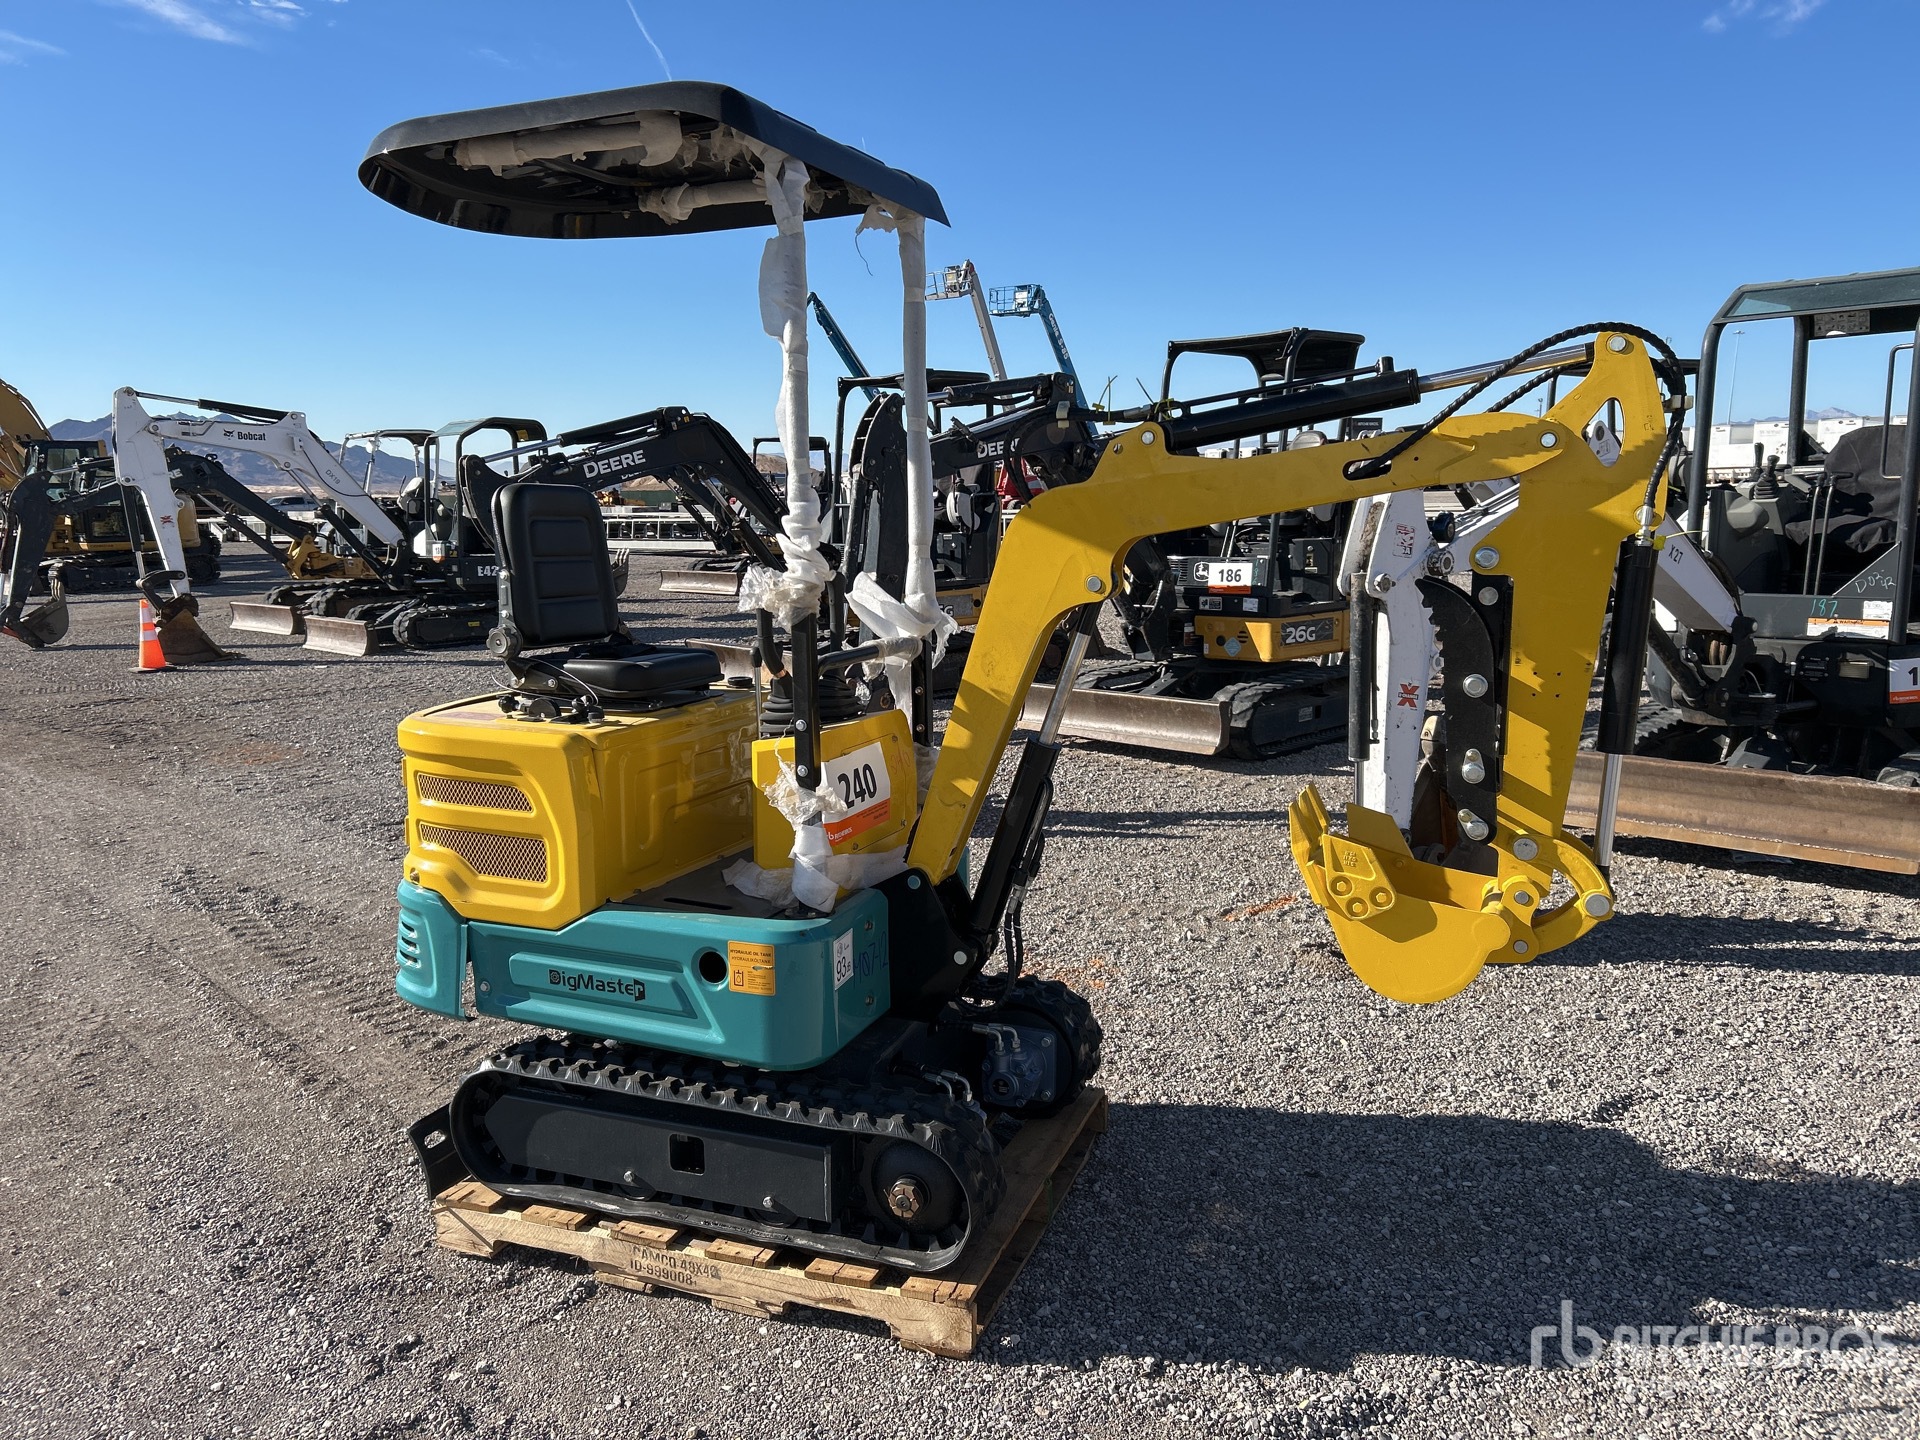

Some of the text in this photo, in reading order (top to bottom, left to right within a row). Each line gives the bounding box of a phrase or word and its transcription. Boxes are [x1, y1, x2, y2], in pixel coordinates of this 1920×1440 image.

[237, 431, 266, 441] Bobcat
[977, 438, 1021, 459] DEE
[583, 449, 647, 479] DEERE
[1218, 568, 1242, 583] 186
[1810, 599, 1838, 617] 187
[1285, 625, 1316, 644] 26G
[837, 763, 877, 810] 240
[836, 956, 847, 982] 93
[548, 968, 646, 1002] DigMaster
